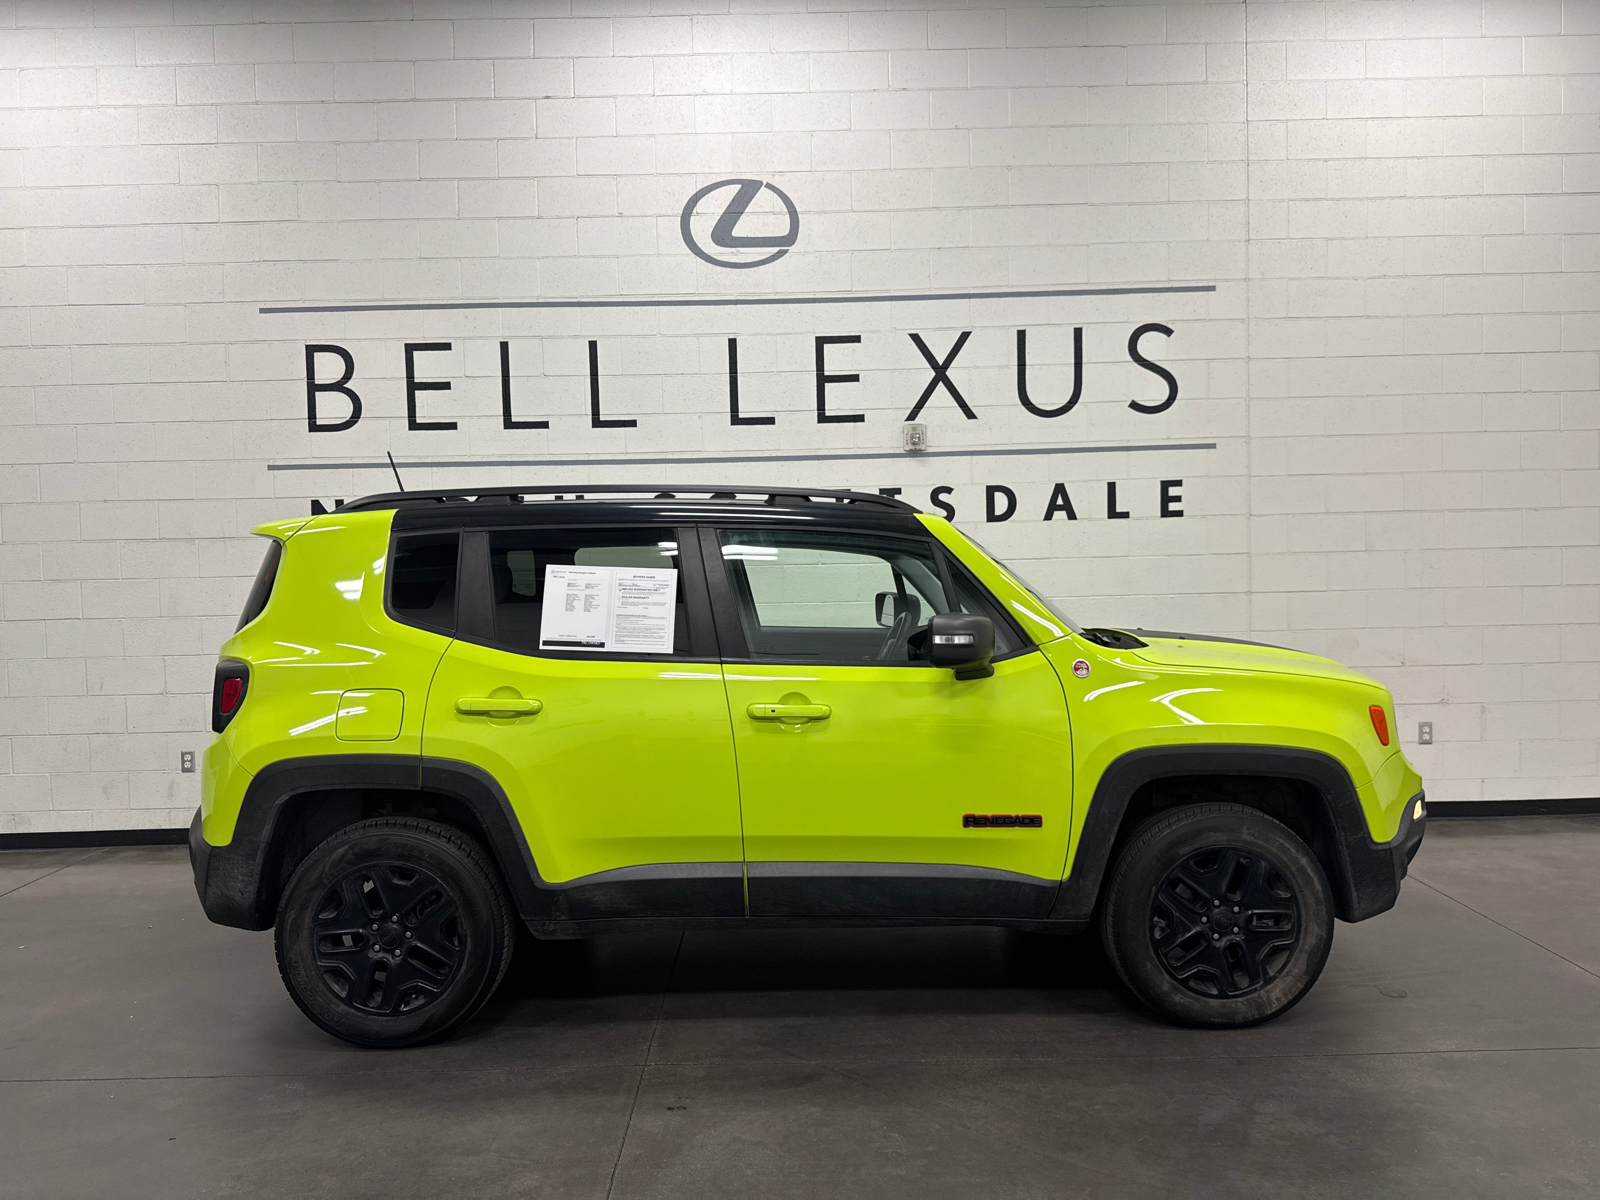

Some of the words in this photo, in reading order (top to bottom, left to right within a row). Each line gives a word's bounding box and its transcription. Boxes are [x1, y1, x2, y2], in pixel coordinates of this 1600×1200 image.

[304, 340, 638, 433] BELL
[727, 322, 1179, 426] LEXUS
[962, 813, 1043, 828] RENEGADE
